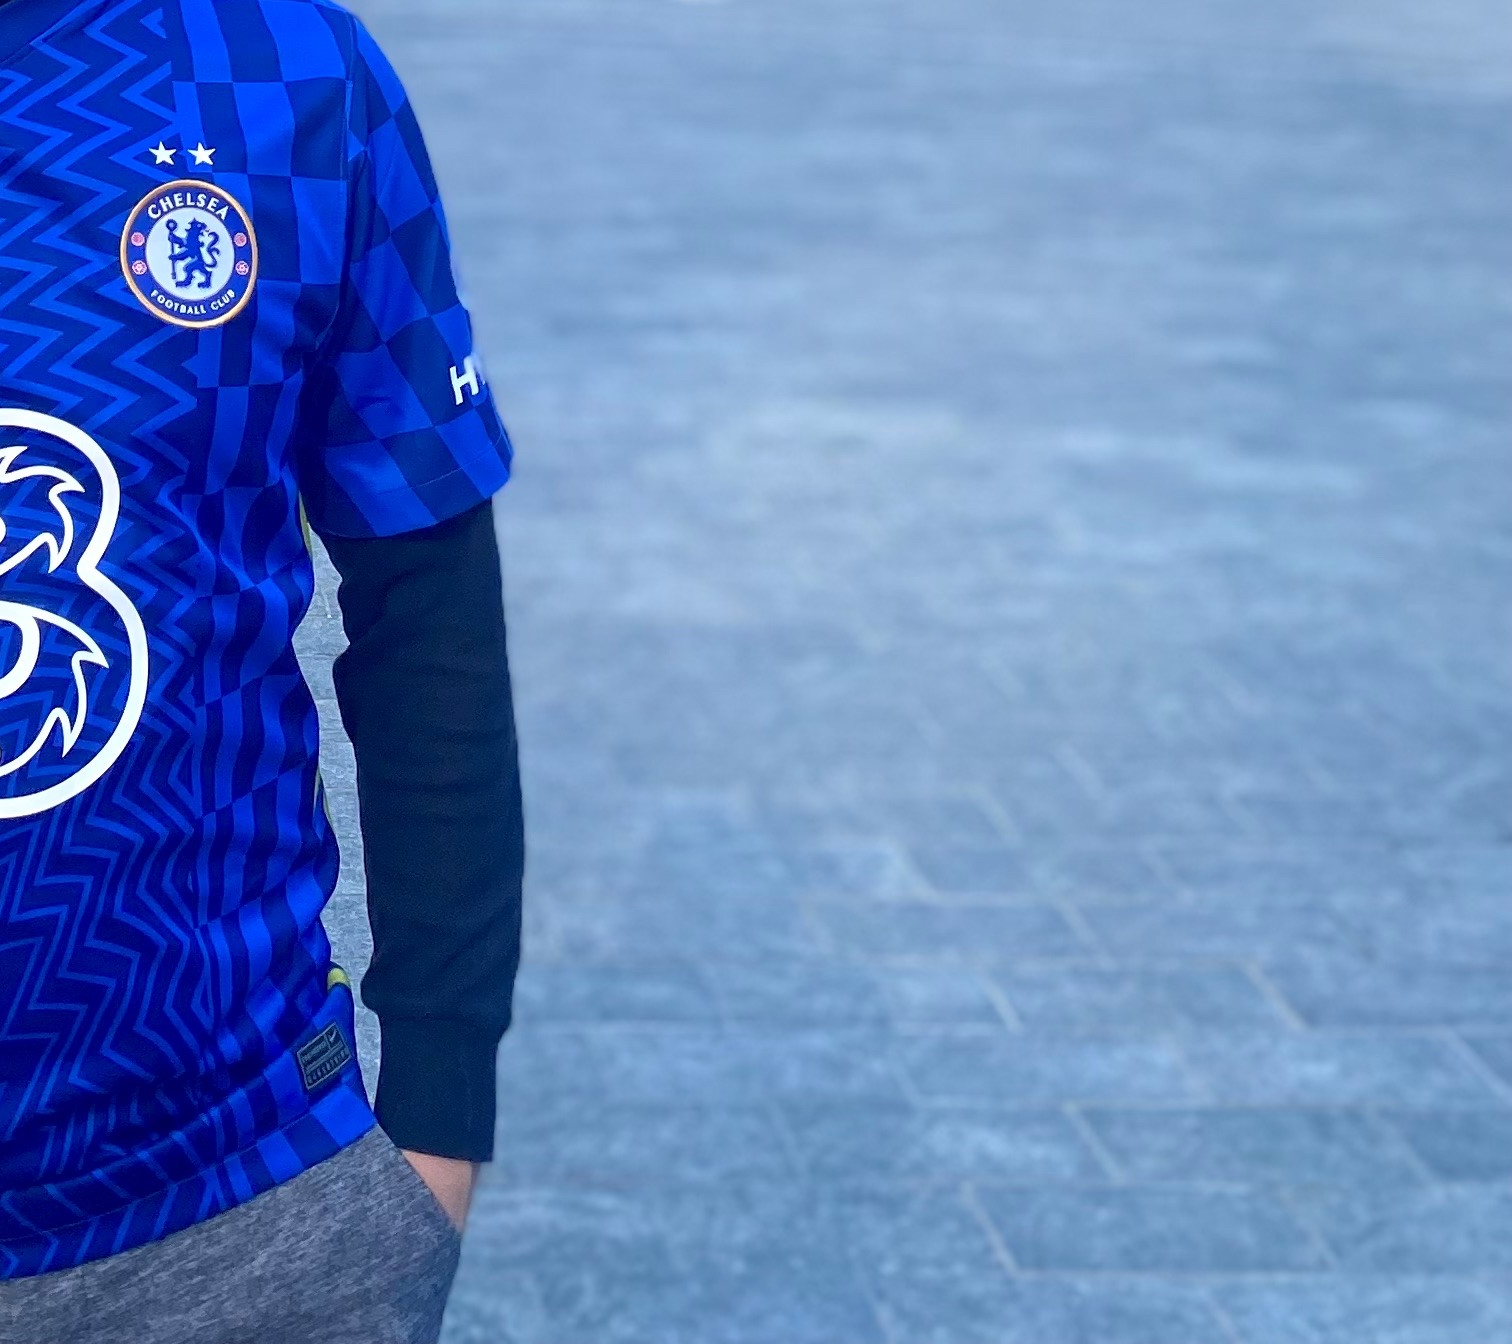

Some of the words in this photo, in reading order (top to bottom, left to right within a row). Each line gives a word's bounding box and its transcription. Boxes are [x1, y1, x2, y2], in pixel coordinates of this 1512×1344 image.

[147, 191, 230, 221] CHELSEA
[150, 289, 207, 315] FOOTBALL
[210, 289, 235, 311] CLUB
[449, 354, 485, 406] H
